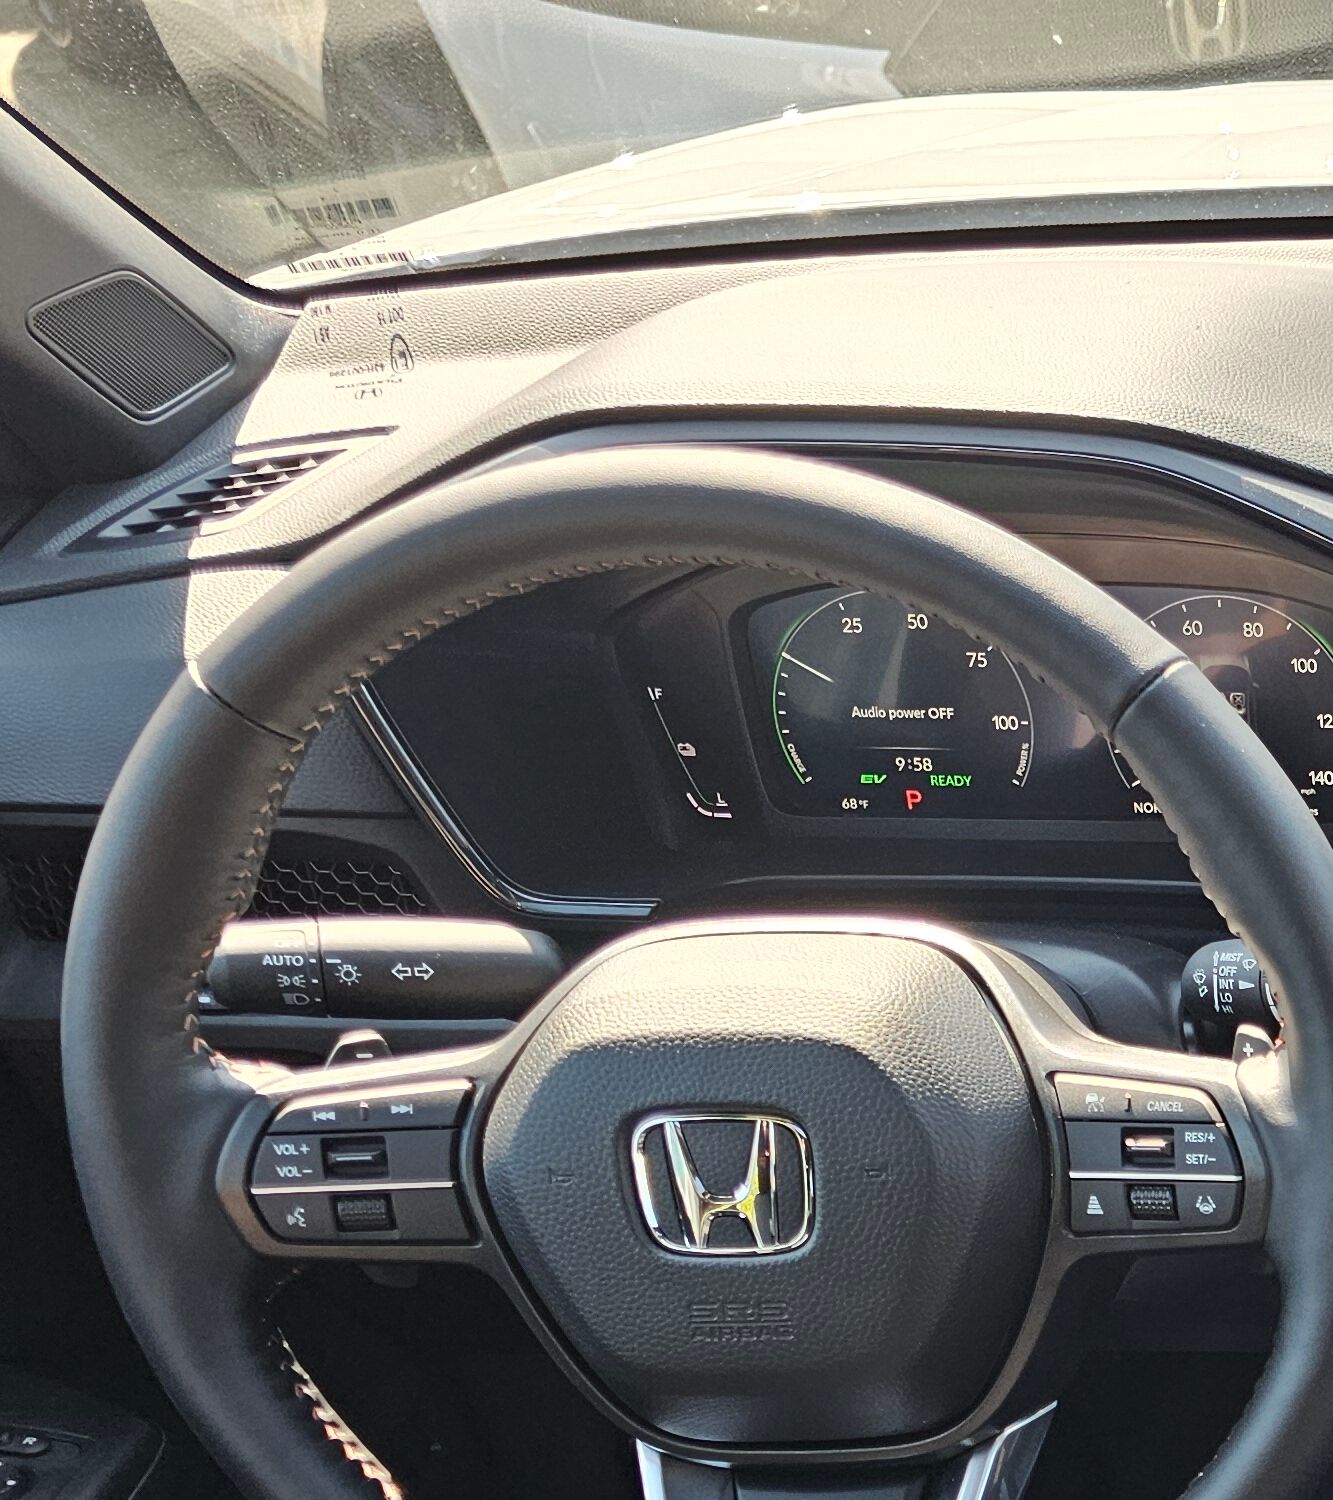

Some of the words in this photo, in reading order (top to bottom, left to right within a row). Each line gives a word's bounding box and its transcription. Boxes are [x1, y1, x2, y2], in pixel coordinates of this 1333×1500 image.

[841, 618, 863, 634] 25
[907, 614, 928, 630] 50
[1182, 621, 1203, 636] 60
[1243, 622, 1264, 638] 80
[965, 652, 988, 668] 75
[1290, 658, 1318, 673] 100
[654, 688, 663, 700] F
[851, 706, 887, 719] Audio
[888, 708, 926, 721] power
[927, 707, 955, 720] OFF
[991, 715, 1019, 731] 100
[895, 757, 933, 772] 9:58
[860, 774, 887, 784] EV
[930, 775, 972, 787] READY
[905, 789, 922, 810] P
[261, 954, 304, 967] AUTO
[1220, 952, 1244, 962] MIST
[1219, 966, 1238, 977] OFF
[1219, 978, 1235, 989] INT
[1219, 991, 1233, 1003] LO
[1147, 1100, 1184, 1113] CANCEL
[1184, 1131, 1217, 1145] RES/+
[273, 1142, 311, 1156] VOL+
